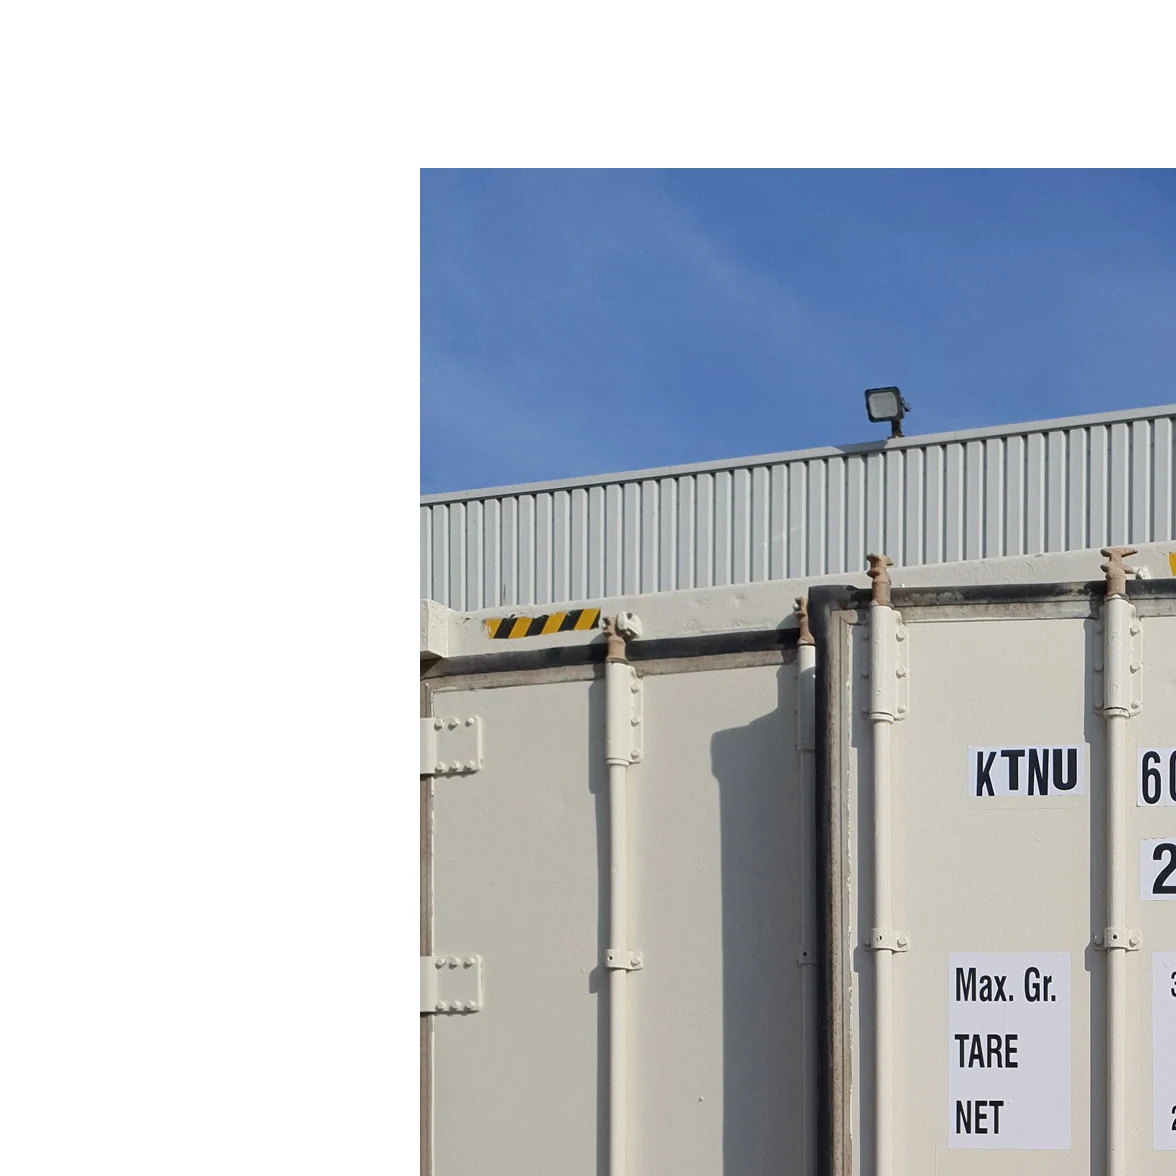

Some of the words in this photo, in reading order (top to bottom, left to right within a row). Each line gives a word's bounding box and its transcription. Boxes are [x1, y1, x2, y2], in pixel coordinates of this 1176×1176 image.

[976, 748, 1078, 797] KTNU
[955, 967, 1014, 1002] Max.
[1024, 966, 1056, 1002] Gr.
[954, 1033, 1019, 1069] TARE
[955, 1100, 1005, 1135] NET
